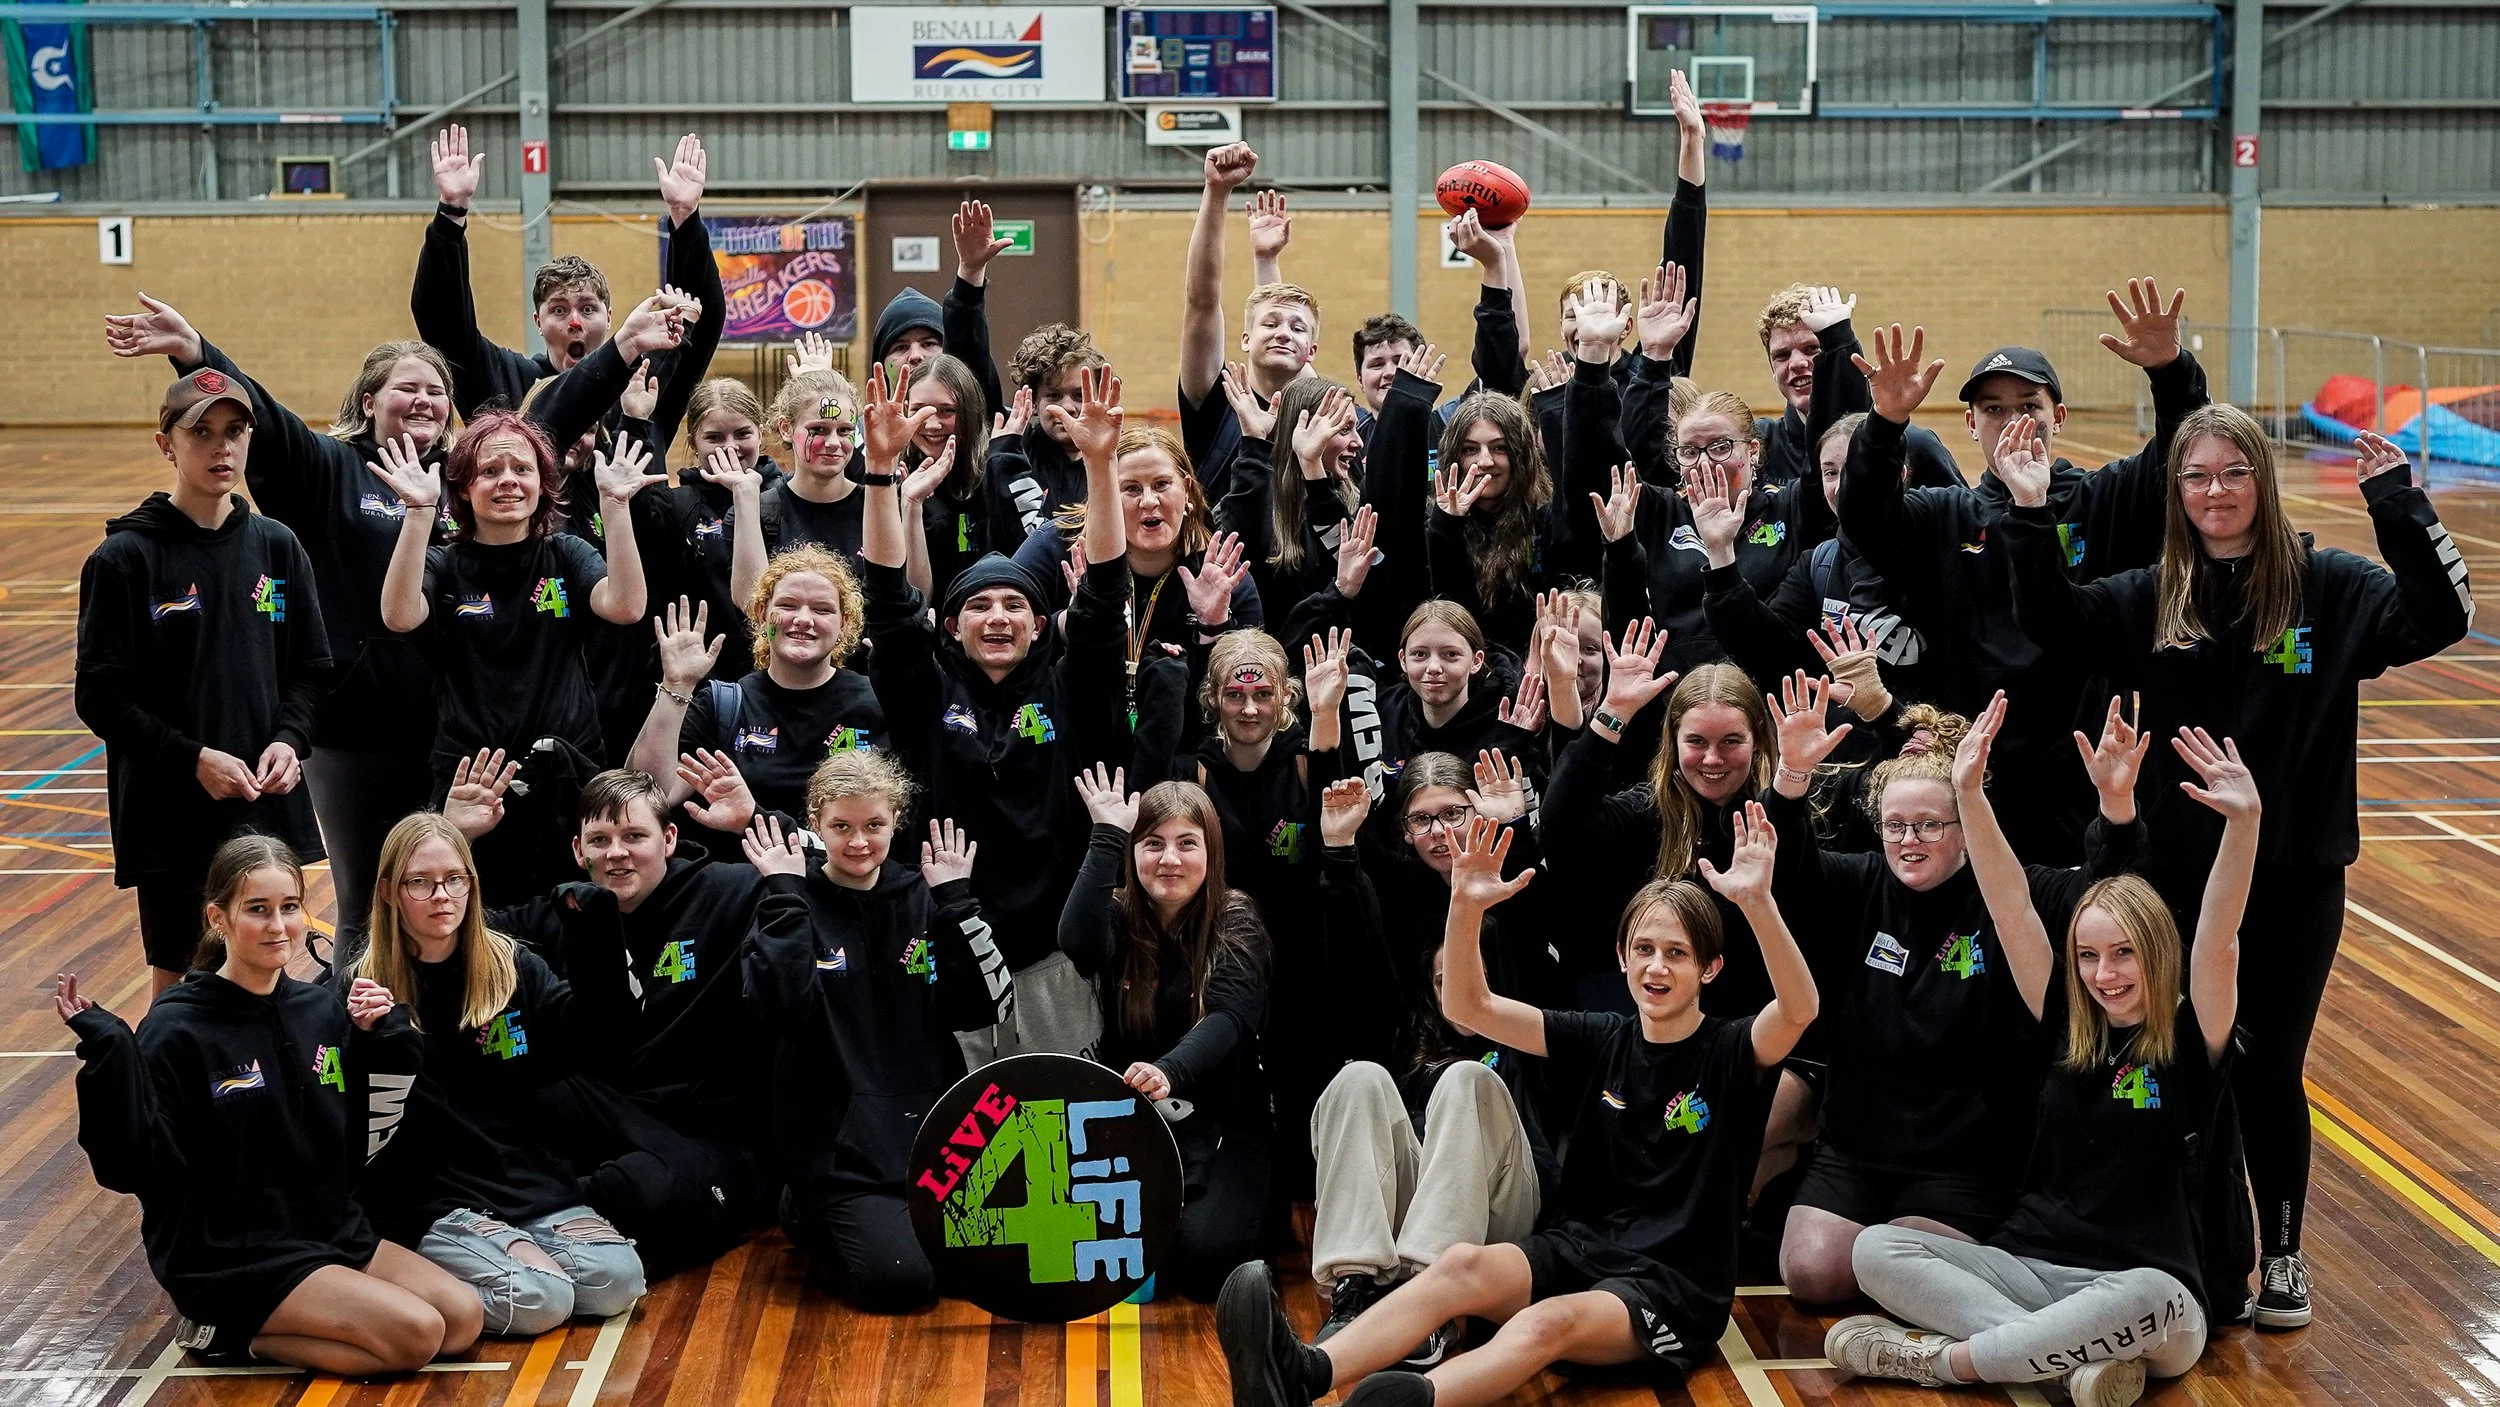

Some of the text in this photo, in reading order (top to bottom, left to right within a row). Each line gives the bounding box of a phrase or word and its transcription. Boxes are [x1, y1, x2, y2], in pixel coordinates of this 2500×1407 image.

[912, 20, 1016, 40] BENALLA
[913, 83, 1043, 98] RURAL CITY
[527, 147, 542, 172] 1
[2238, 141, 2255, 166] 2
[1437, 180, 1504, 208] SHERRIN
[108, 224, 122, 257] 1
[722, 226, 781, 255] HOME
[804, 222, 846, 250] THE
[725, 251, 842, 321] BREAKERS
[1749, 523, 1779, 547] 4
[256, 577, 277, 612] 4
[536, 577, 566, 618] 4
[2263, 628, 2301, 674] 4
[828, 727, 856, 757] 4
[1018, 703, 1047, 745] 4
[1271, 822, 1298, 864] 4
[653, 941, 686, 984] 4
[905, 939, 931, 985] 4
[1941, 935, 1974, 980] 4
[483, 1013, 518, 1060] 4
[319, 1047, 346, 1092] 4
[2112, 1066, 2150, 1109] 4
[1664, 1093, 1701, 1134] 4
[943, 1098, 1098, 1284] 4
[2028, 1292, 2185, 1375] EVERLAST
